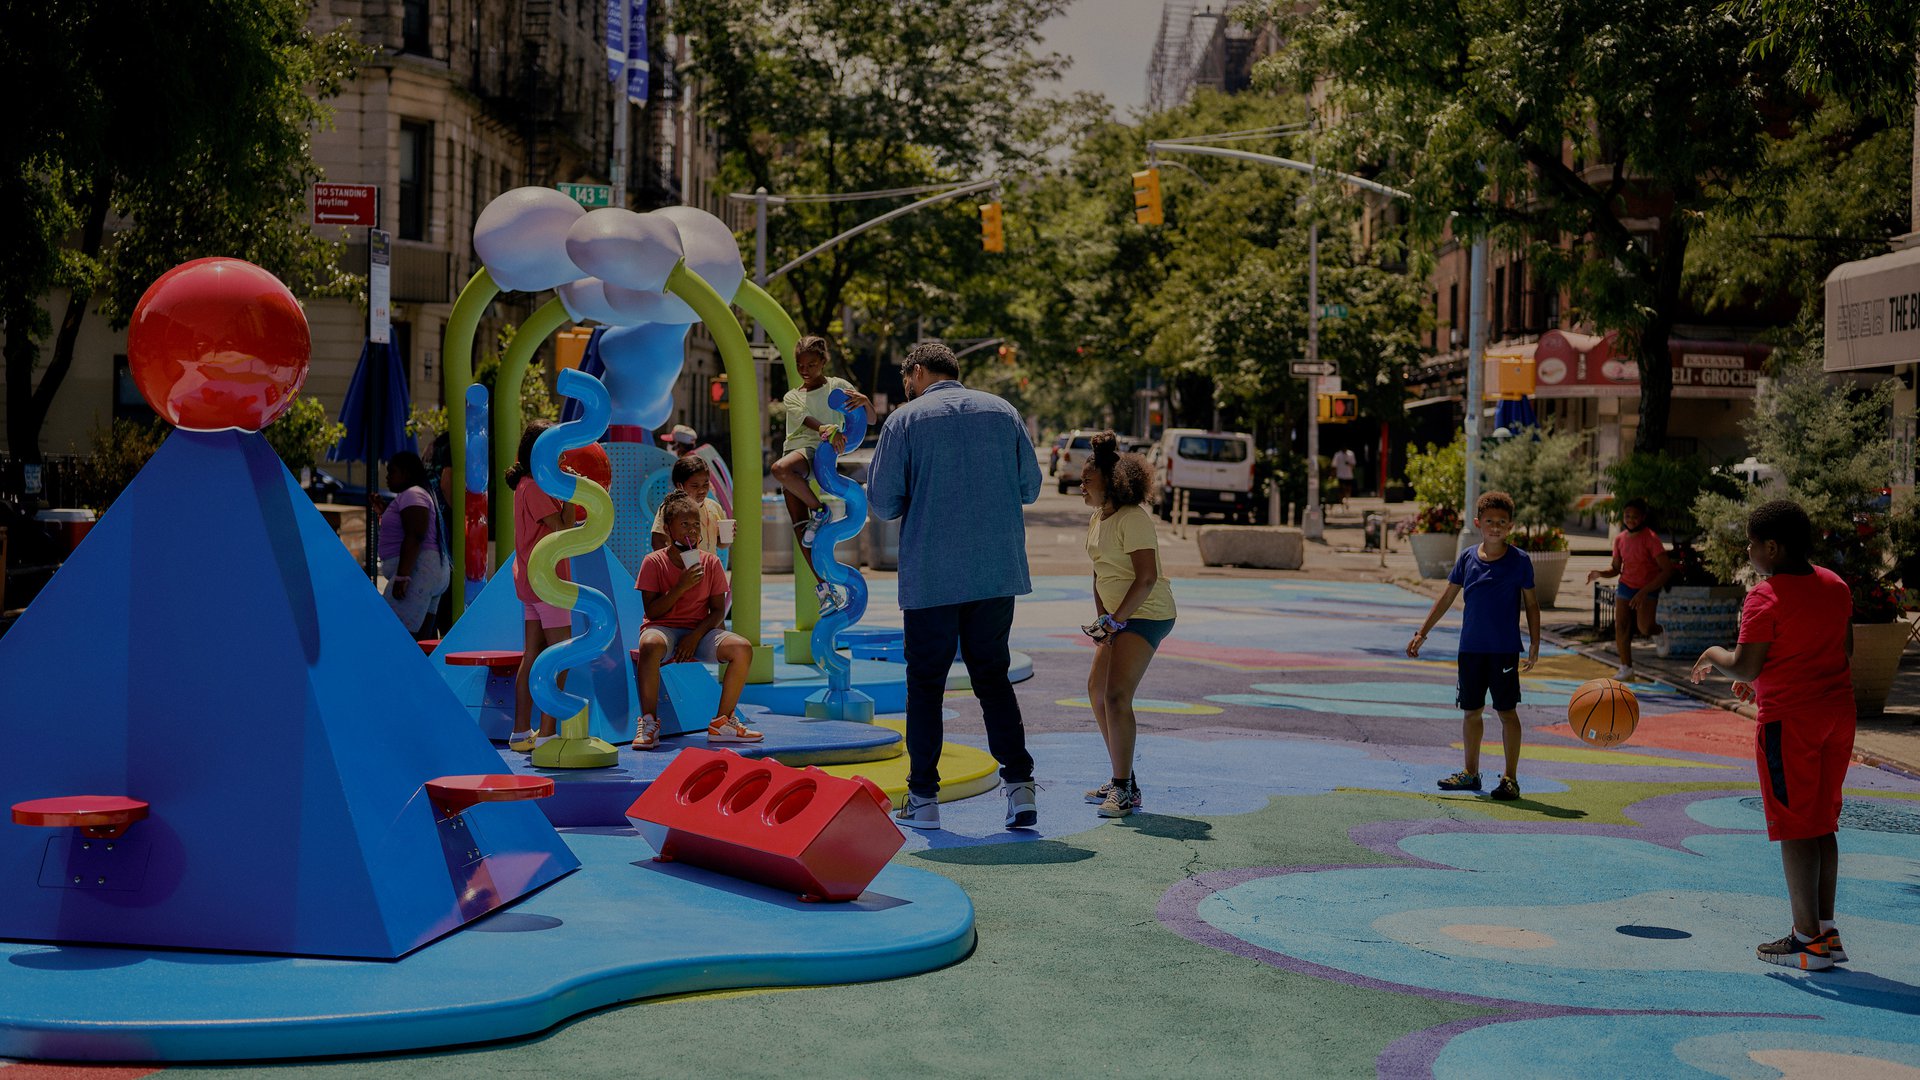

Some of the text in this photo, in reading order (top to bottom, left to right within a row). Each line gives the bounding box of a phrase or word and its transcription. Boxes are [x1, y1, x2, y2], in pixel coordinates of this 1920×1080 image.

[317, 188, 367, 198] NO STANDING
[575, 187, 595, 204] 143
[317, 198, 349, 208] Anytime
[1889, 295, 1908, 332] THE
[1911, 293, 1920, 330] B
[1671, 367, 1692, 384] ELI
